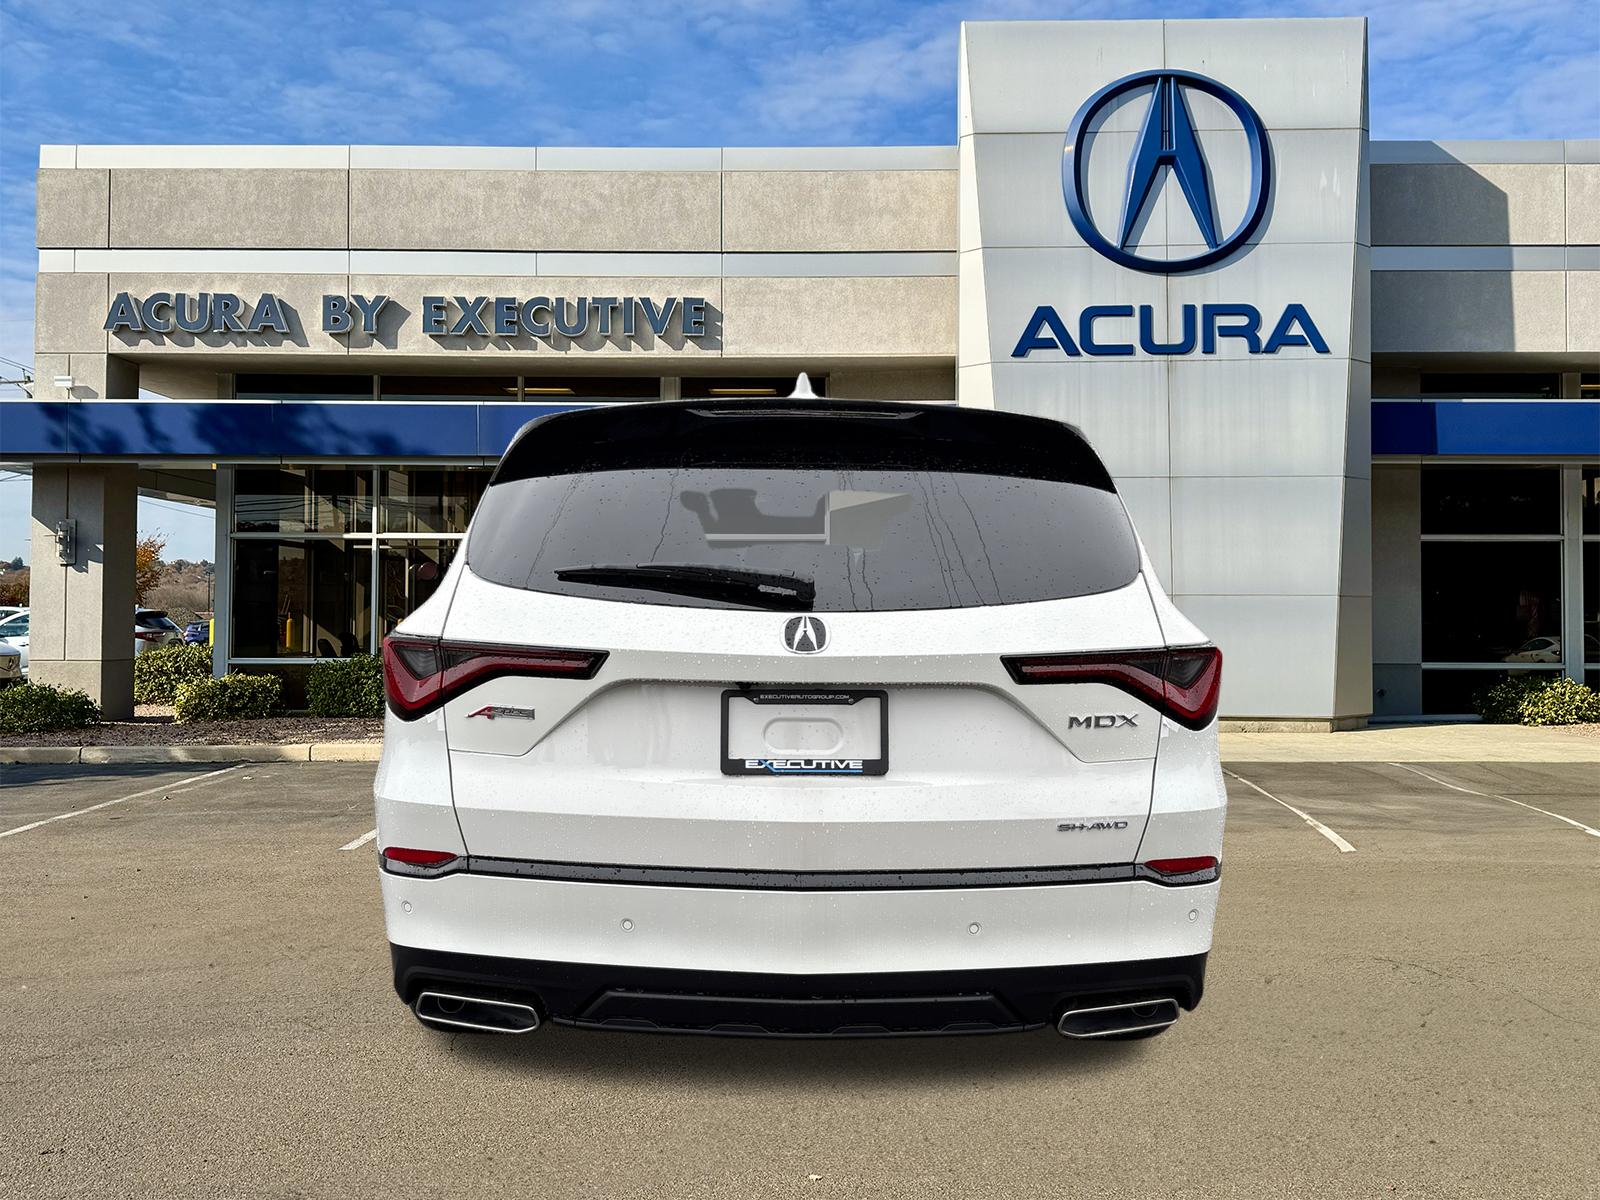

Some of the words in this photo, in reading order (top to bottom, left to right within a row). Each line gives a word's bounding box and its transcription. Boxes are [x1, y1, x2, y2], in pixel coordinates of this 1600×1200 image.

[103, 292, 290, 334] ACURA
[322, 294, 391, 334] BY
[422, 296, 706, 337] EXECUTIVE
[1010, 303, 1332, 357] ACURA
[1068, 713, 1139, 730] MDX
[745, 759, 863, 769] EXECUTIVE
